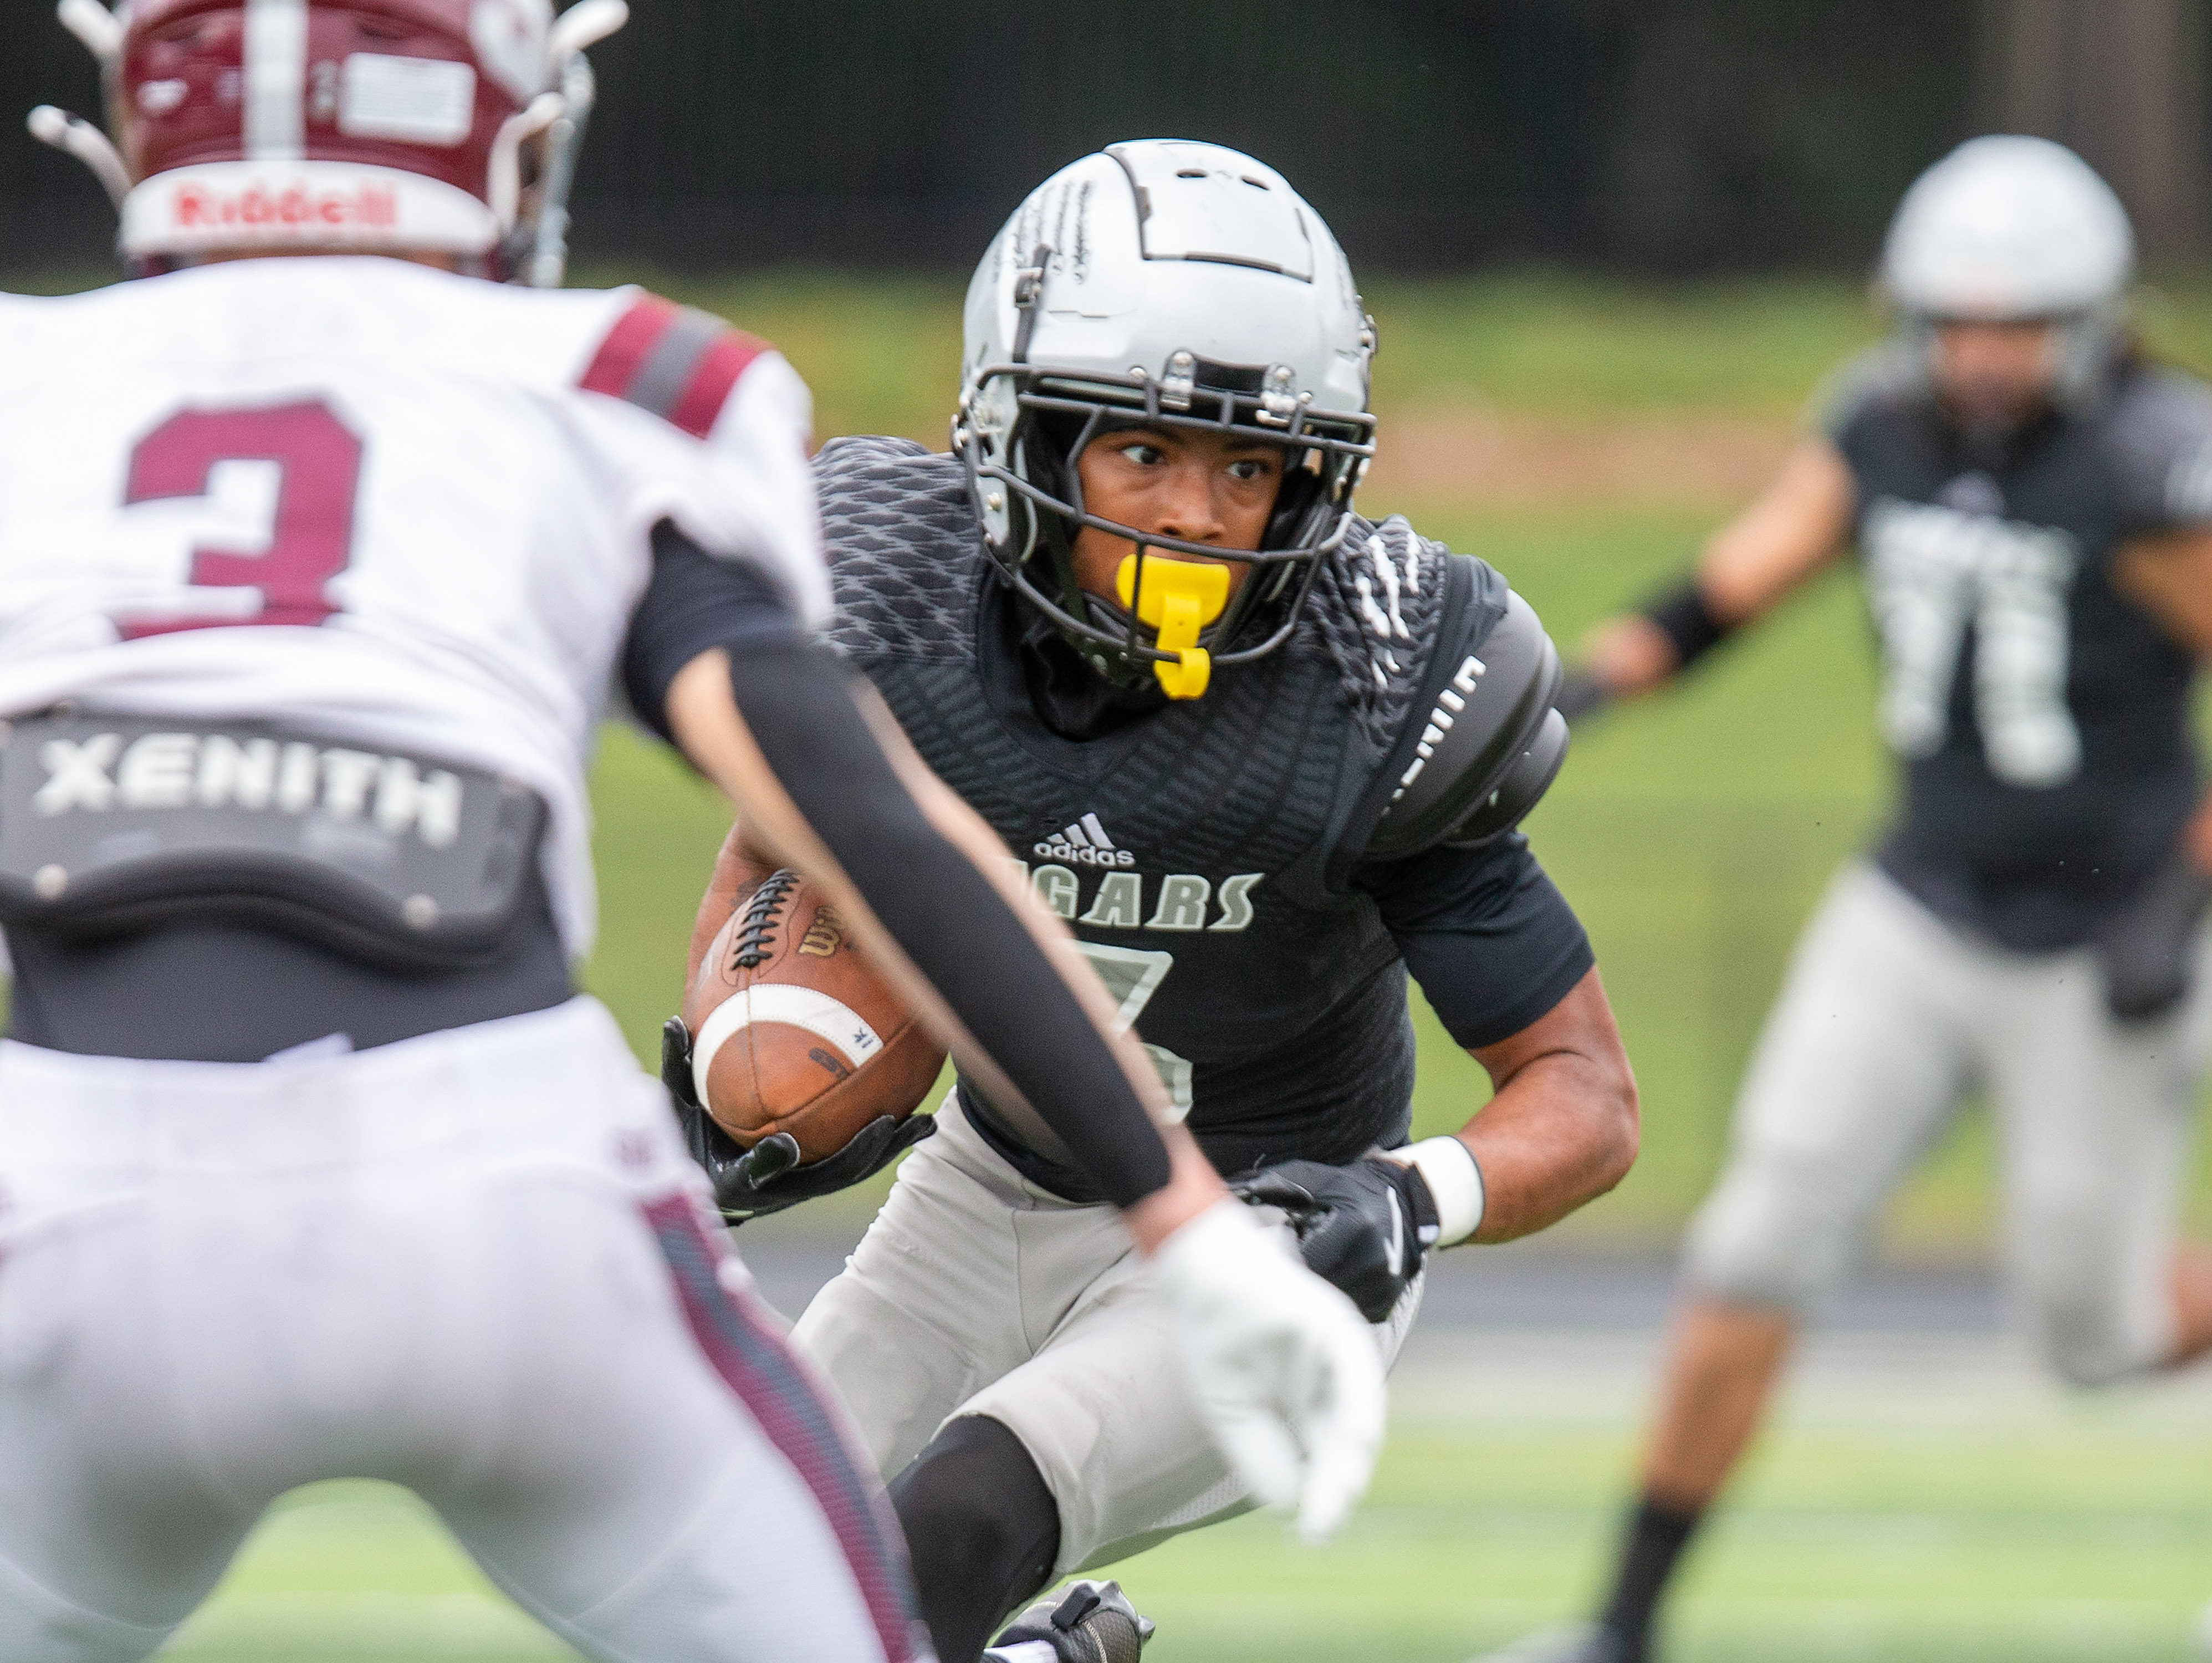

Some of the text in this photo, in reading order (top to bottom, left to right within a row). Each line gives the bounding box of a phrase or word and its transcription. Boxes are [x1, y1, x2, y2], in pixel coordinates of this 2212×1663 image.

[173, 181, 397, 227] Riddell
[119, 400, 366, 642] 3
[35, 730, 463, 845] XENITH
[1033, 841, 1136, 866] adidas
[1012, 859, 1265, 932] GARS
